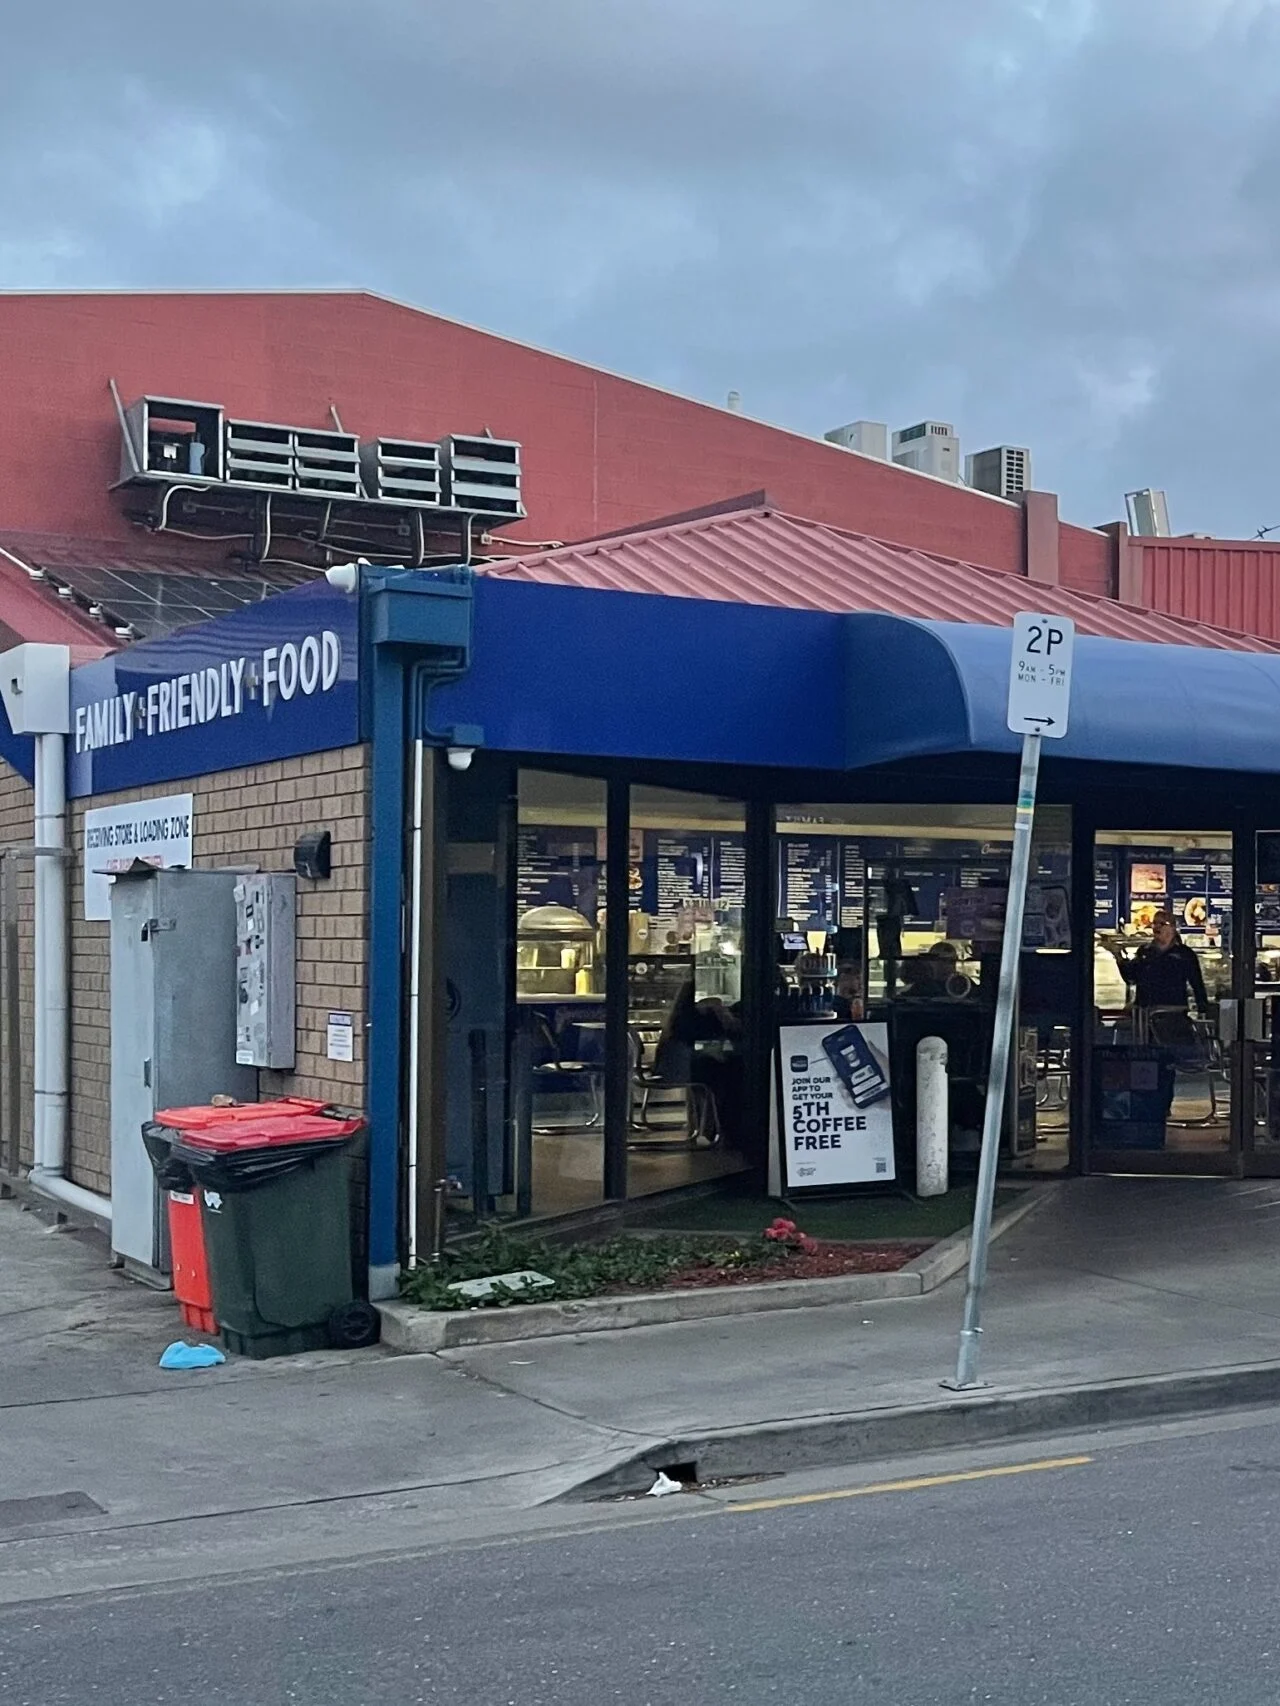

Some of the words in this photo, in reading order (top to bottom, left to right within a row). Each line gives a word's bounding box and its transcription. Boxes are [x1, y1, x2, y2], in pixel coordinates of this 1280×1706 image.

[1026, 625, 1064, 656] 2P
[1018, 673, 1036, 683] MON
[1050, 677, 1065, 687] FRI
[75, 691, 137, 754] FAMILY
[146, 657, 245, 736] FRIENDLY
[263, 630, 339, 707] FOOD
[140, 818, 169, 842] LOADING
[171, 815, 189, 839] ZONE
[792, 1077, 811, 1086] JOIN
[812, 1076, 831, 1084] OUR
[792, 1085, 808, 1093] APP
[792, 1093, 808, 1101] GET
[810, 1092, 833, 1100] YOUR
[792, 1101, 830, 1120] 5TH
[792, 1115, 867, 1134] COFFEE
[793, 1134, 842, 1151] FREE
